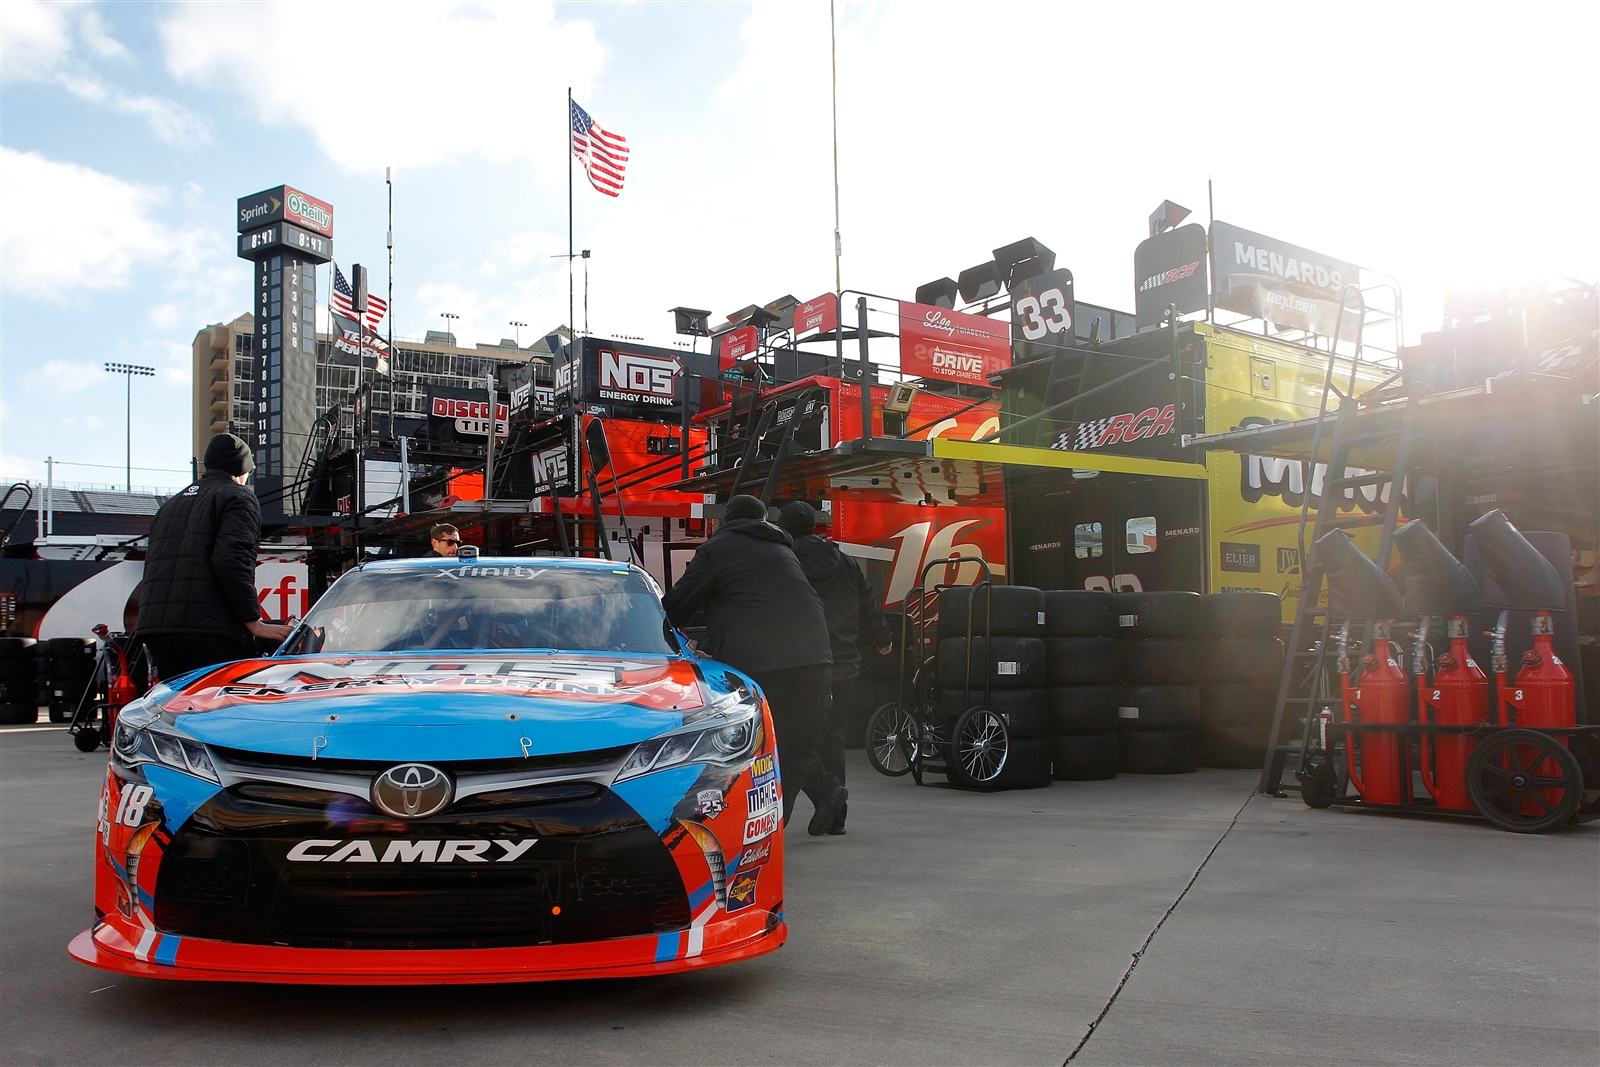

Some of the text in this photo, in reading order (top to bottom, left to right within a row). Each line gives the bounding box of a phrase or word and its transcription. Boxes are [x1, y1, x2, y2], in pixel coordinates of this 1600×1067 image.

[240, 202, 268, 222] Sprint
[288, 193, 330, 229] O'Reilly
[251, 229, 272, 248] 8:47
[299, 232, 322, 252] 8:47
[262, 261, 267, 271] 1
[292, 260, 297, 270] 1
[1234, 241, 1343, 291] MENARDS
[262, 275, 267, 287] 2
[292, 274, 297, 285] 2
[262, 292, 267, 303] 3
[292, 291, 297, 301] 3
[1267, 291, 1317, 313] nexteer
[262, 306, 267, 317] 4
[292, 306, 297, 317] 4
[1016, 288, 1071, 340] 33
[262, 323, 267, 334] 5
[292, 323, 297, 334] 5
[923, 311, 990, 338] Lilly DIABETES
[262, 337, 267, 349] 6
[292, 337, 297, 348] 6
[343, 329, 389, 350] TEAM
[262, 356, 267, 367] 7
[932, 352, 983, 373] DRIVE
[262, 370, 267, 381] 8
[601, 352, 682, 394] NOS
[941, 368, 956, 376] STOP
[262, 387, 267, 398] 9
[599, 390, 674, 406] ENERGY DRINK
[258, 402, 267, 413] 10
[258, 419, 267, 430] 11
[1096, 404, 1176, 447] RCR
[258, 434, 267, 445] 12
[532, 445, 568, 484] NOS
[1029, 541, 1061, 551] MENARDS
[885, 519, 983, 605] 16
[1226, 552, 1256, 566] ELJER
[435, 565, 548, 580] xfinity
[1355, 690, 1361, 700] 1
[1432, 690, 1440, 700] 2
[1515, 690, 1523, 700] 3
[750, 755, 774, 778] MOOG
[747, 780, 778, 813] MAHLE
[115, 783, 154, 828] 18
[702, 800, 722, 814] 25
[286, 838, 539, 863] CAMRY
